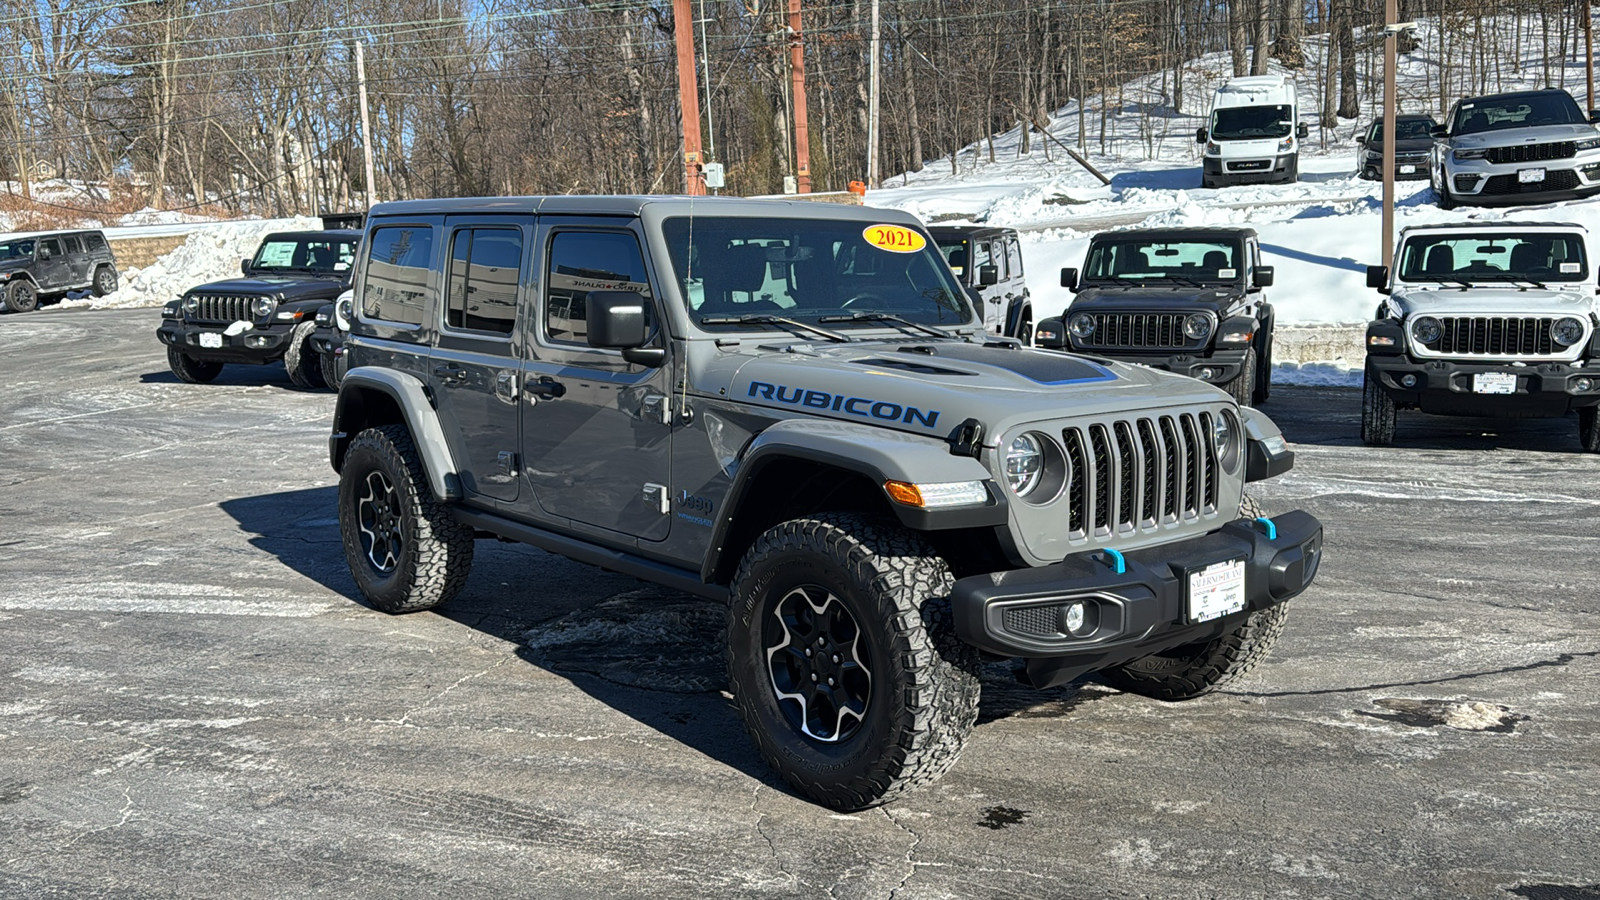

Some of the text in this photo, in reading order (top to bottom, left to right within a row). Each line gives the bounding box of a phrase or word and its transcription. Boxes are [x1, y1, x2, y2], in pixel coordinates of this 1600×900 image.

[876, 229, 913, 246] 2021
[748, 381, 940, 428] RUBICON
[676, 489, 714, 516] Jeep
